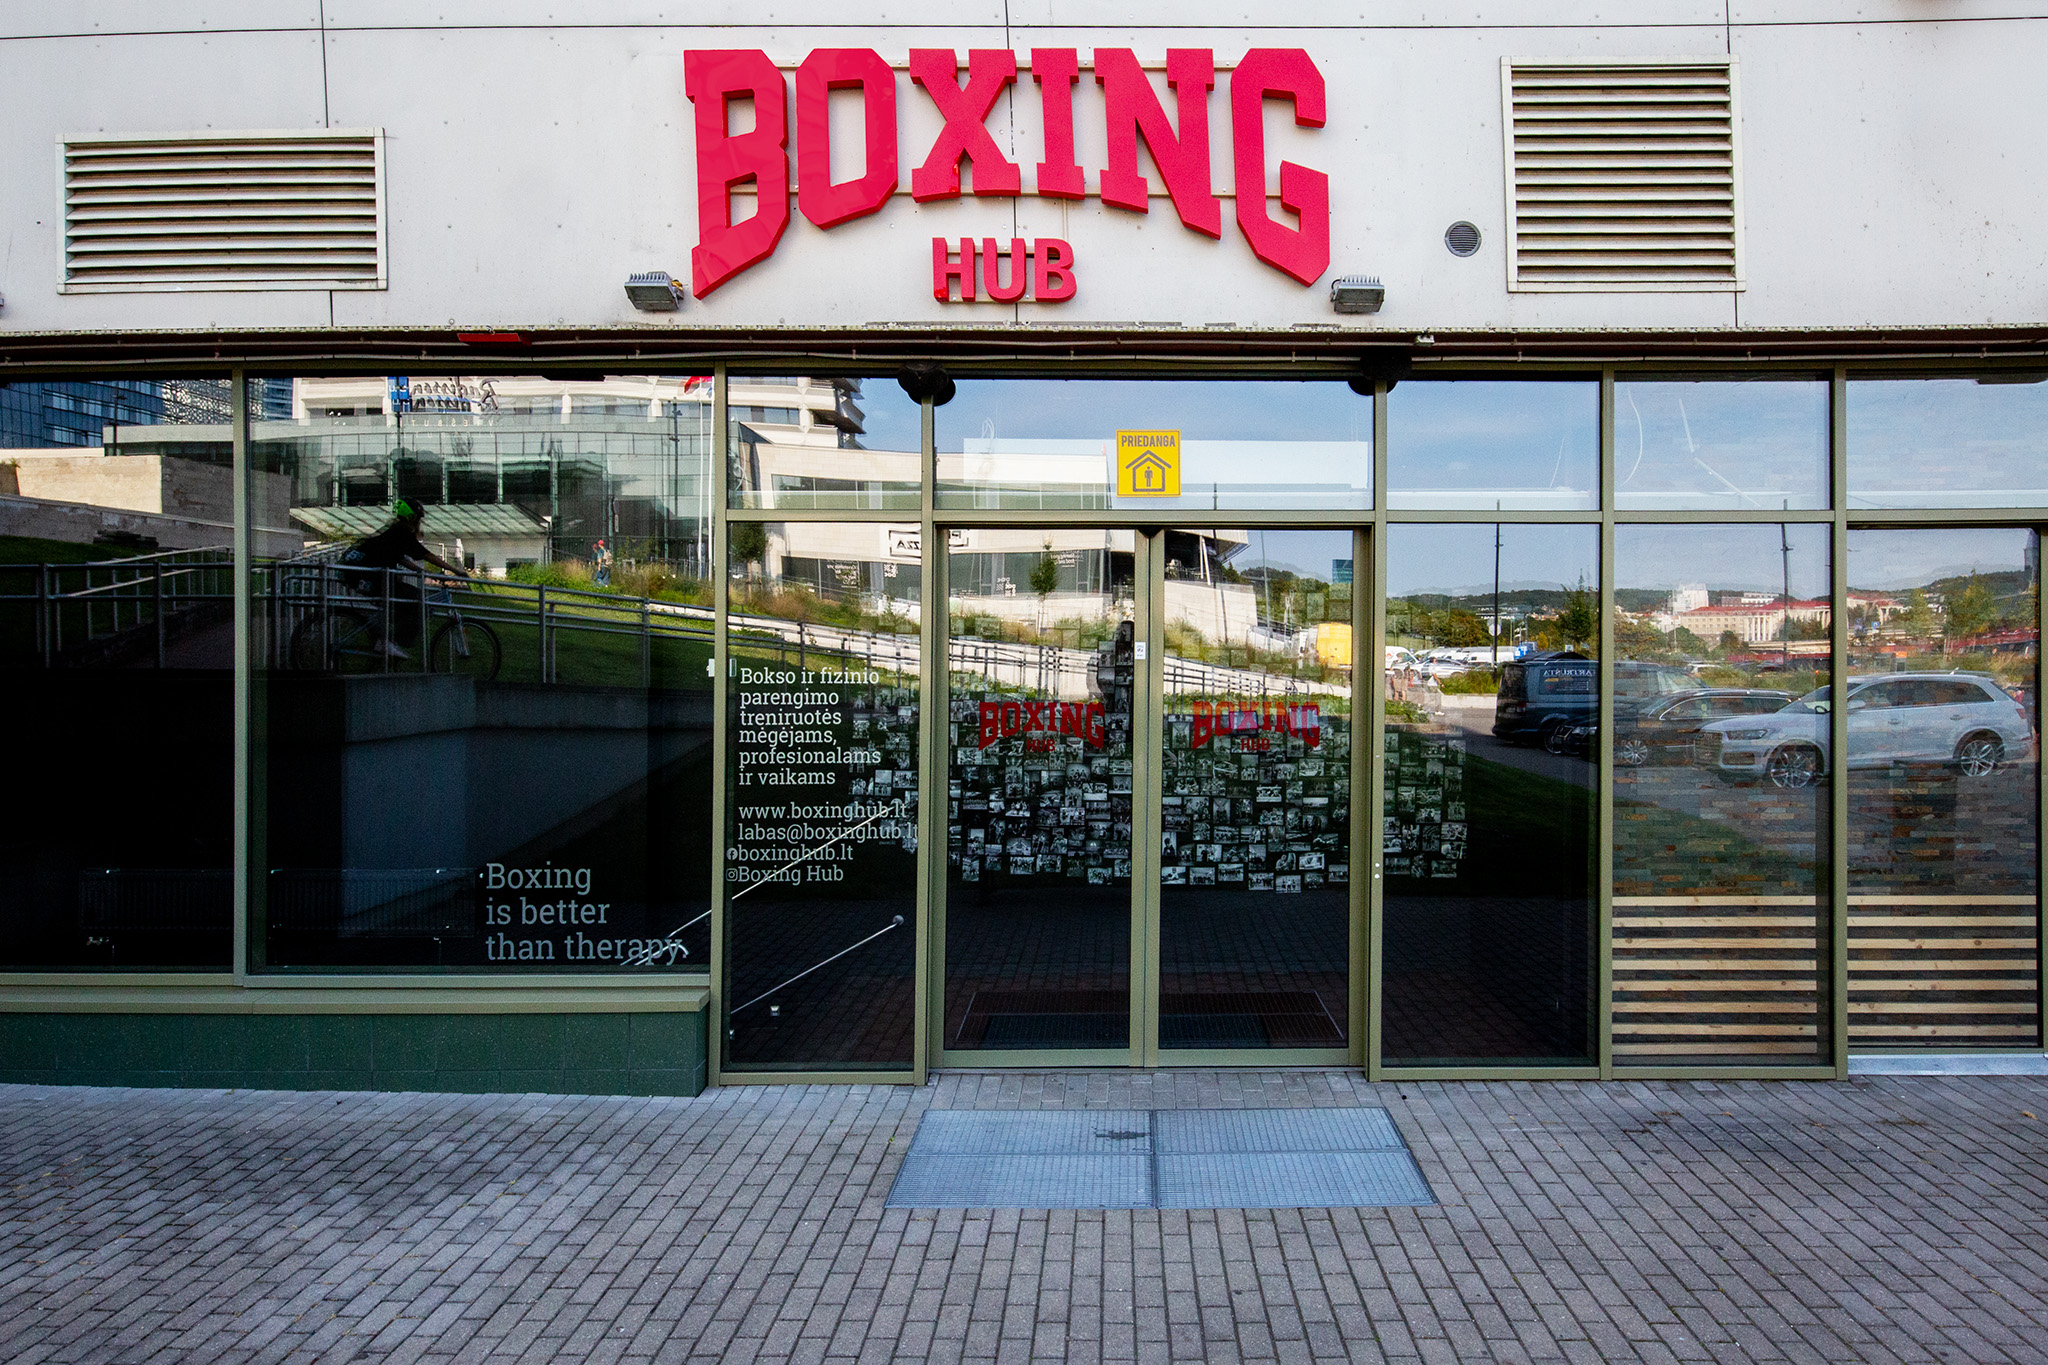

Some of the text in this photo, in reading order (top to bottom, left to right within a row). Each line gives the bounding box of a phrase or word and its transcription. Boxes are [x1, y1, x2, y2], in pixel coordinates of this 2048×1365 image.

[684, 47, 1330, 300] BOXING
[932, 237, 1077, 303] HUB
[1121, 435, 1176, 448] PRIEDANGA
[740, 667, 880, 685] Bokso ir fizinio
[740, 688, 839, 709] parengimo
[740, 708, 842, 726] treniruotės
[979, 701, 1105, 751] BOXING
[1192, 701, 1321, 751] BOXING
[739, 726, 837, 748] mėgėjams,
[1026, 739, 1056, 752] HUB
[1241, 738, 1270, 751] HUB
[738, 747, 881, 769] profesionalams
[739, 768, 836, 785] ir vaikams
[738, 801, 907, 823] www.boxinghub.lt
[738, 822, 918, 844] labas@boxinghub.lt
[738, 844, 854, 866] boxinghub.lt
[486, 861, 591, 895] Boxing
[738, 865, 844, 886] Boxing Hub
[485, 896, 610, 925] is better
[485, 932, 687, 966] than therapy.
